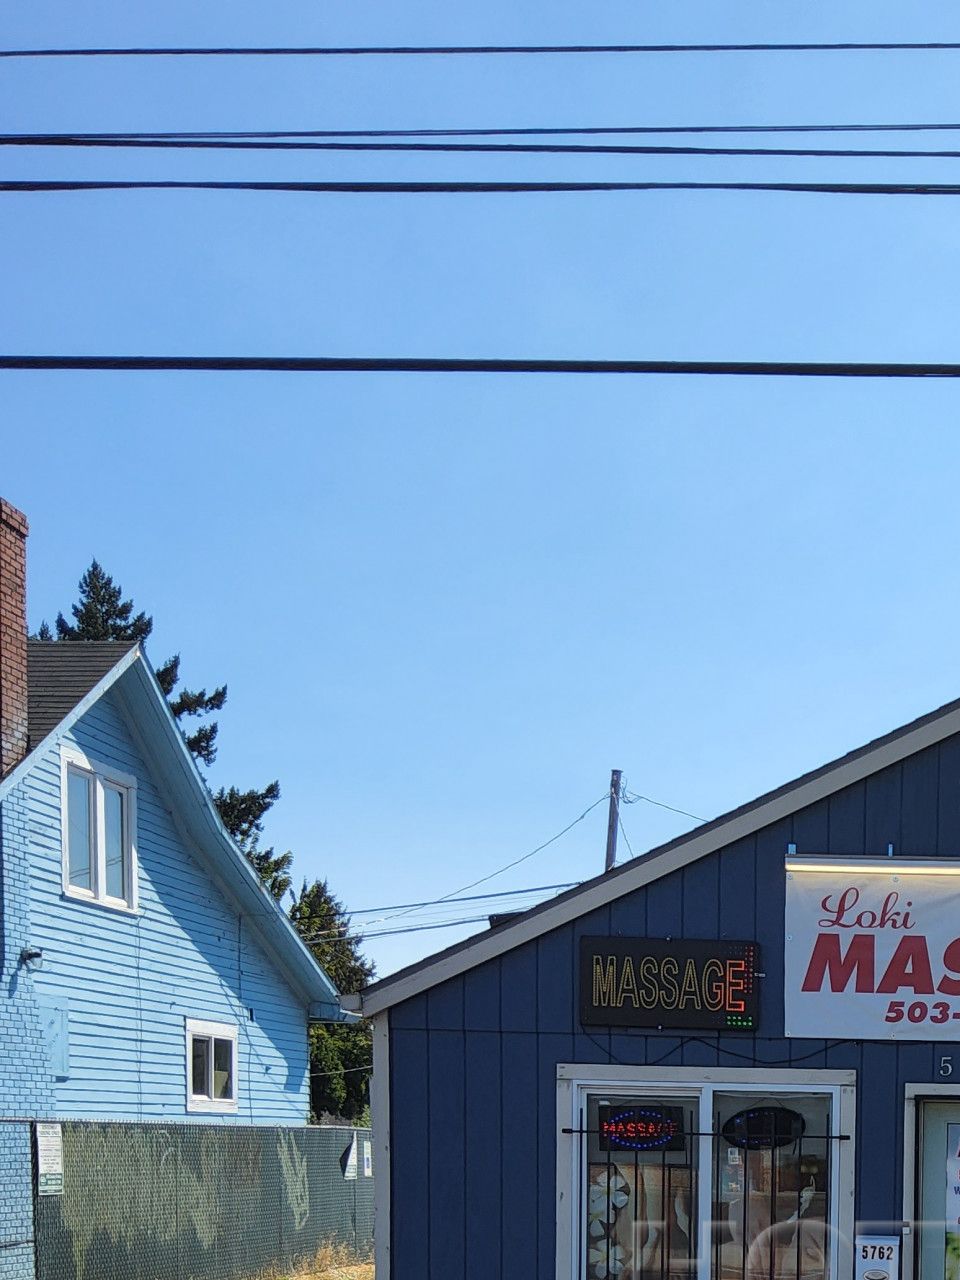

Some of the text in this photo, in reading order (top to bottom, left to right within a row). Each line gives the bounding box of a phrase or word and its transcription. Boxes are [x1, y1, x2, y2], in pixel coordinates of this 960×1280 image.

[817, 886, 917, 930] Loki
[592, 954, 745, 1012] MASSAGE
[862, 1245, 894, 1260] 5762
